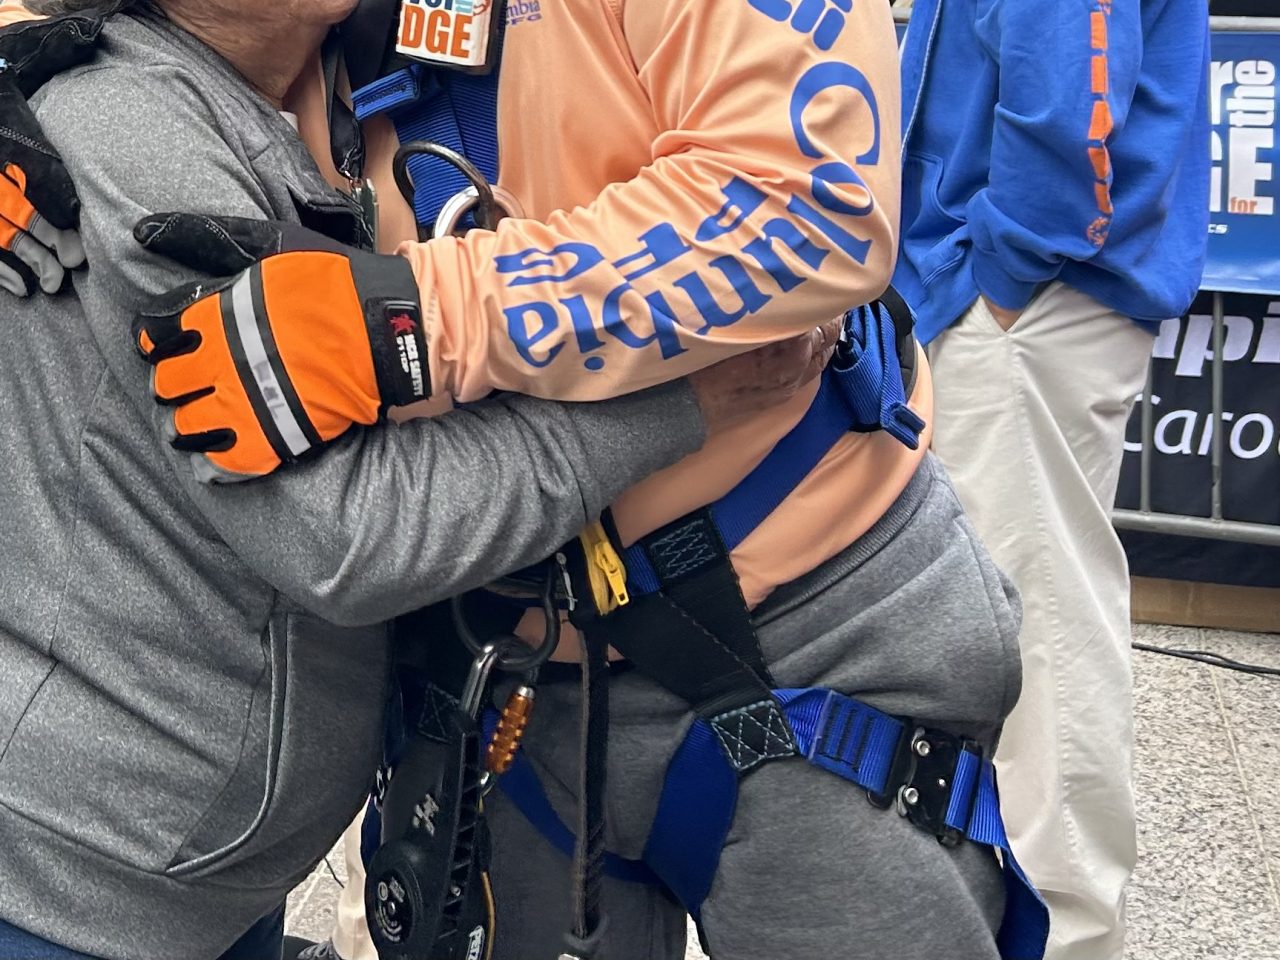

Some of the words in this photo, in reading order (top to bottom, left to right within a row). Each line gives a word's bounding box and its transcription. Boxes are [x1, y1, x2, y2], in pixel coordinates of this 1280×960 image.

[396, 4, 473, 58] DGE
[1226, 60, 1276, 127] the
[502, 60, 882, 371] Columbia
[1230, 196, 1258, 214] for
